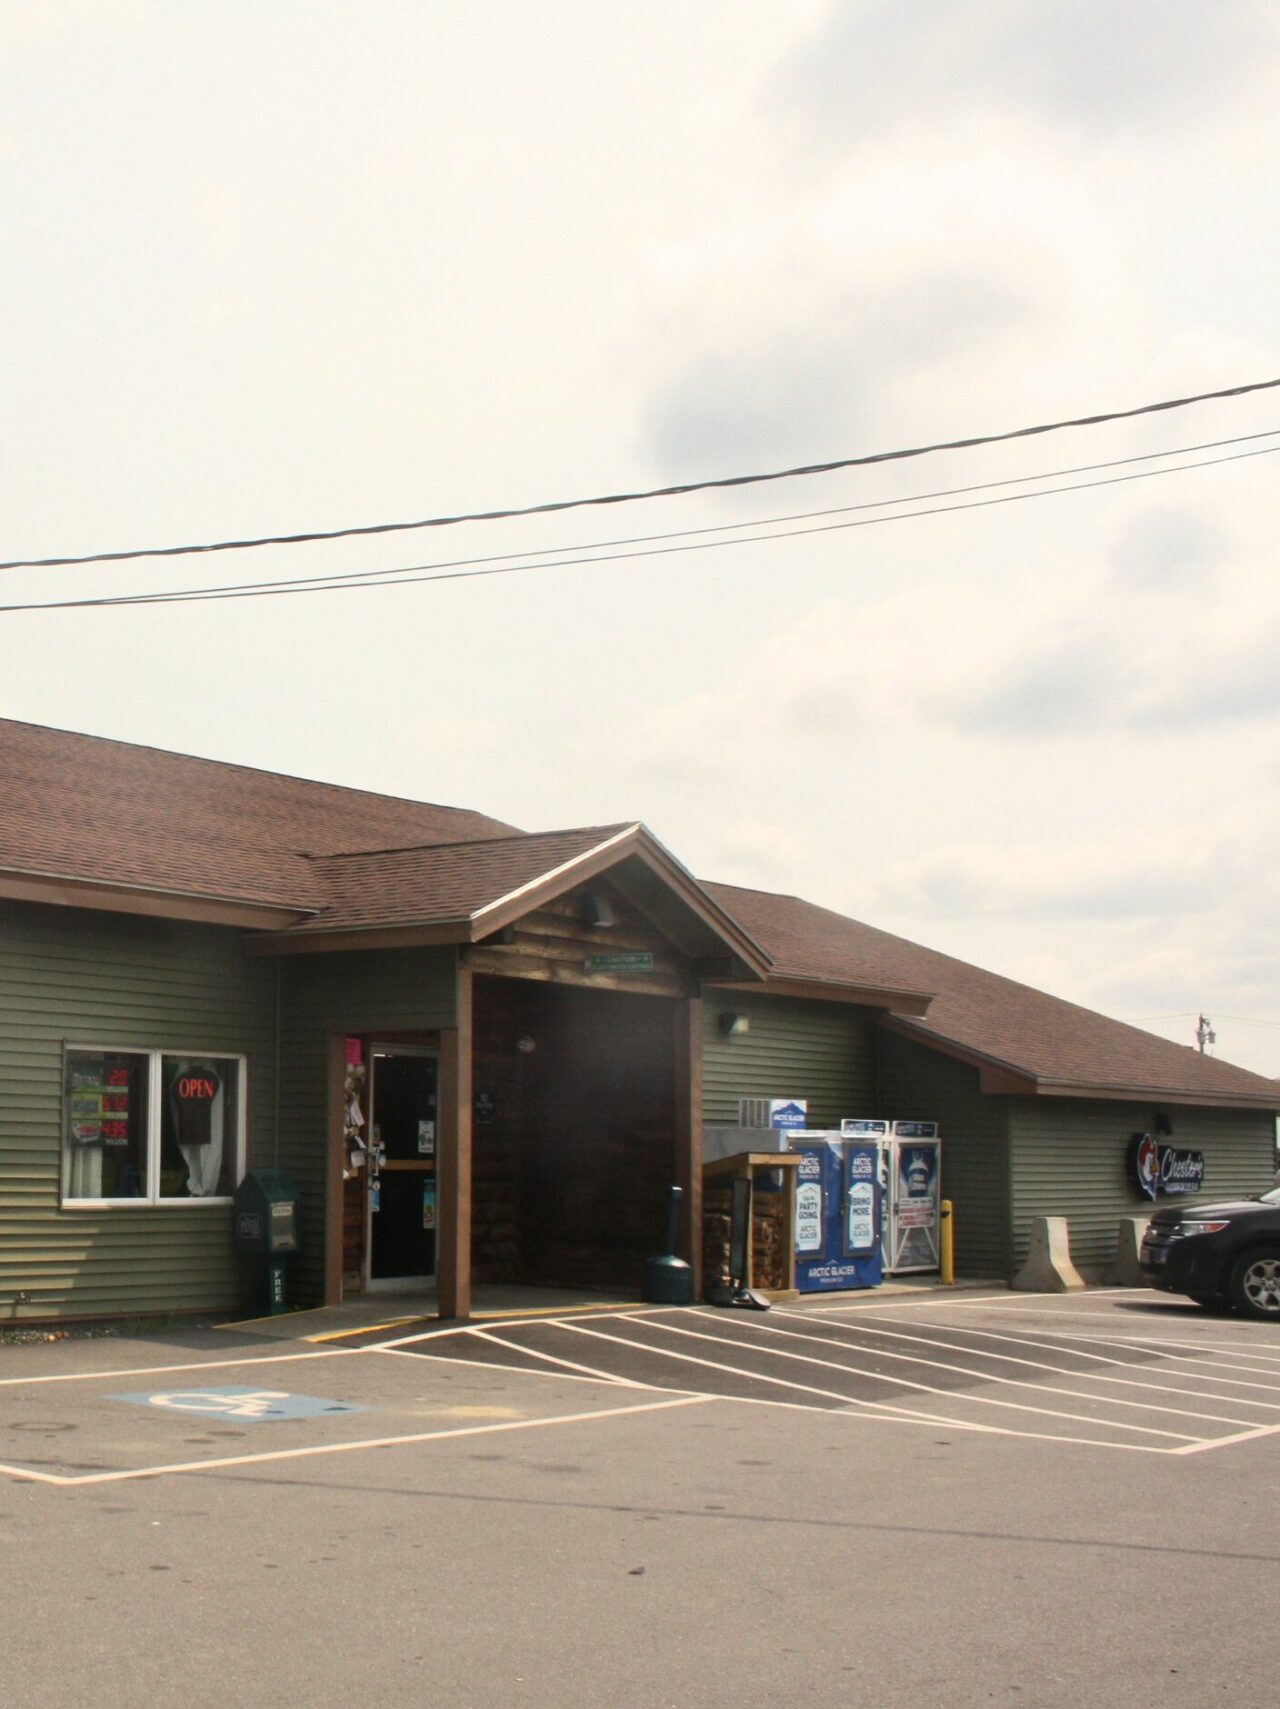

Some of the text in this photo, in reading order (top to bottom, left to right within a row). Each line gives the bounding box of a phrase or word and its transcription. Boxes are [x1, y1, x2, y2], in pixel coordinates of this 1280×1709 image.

[179, 1078, 215, 1098] OPEN
[852, 1157, 872, 1166] ARCTIC
[798, 1165, 820, 1174] GLACIER
[852, 1165, 872, 1174] GLACIER
[799, 1202, 818, 1210] PARTY
[808, 1265, 855, 1277] ARCTIC GLACIER
